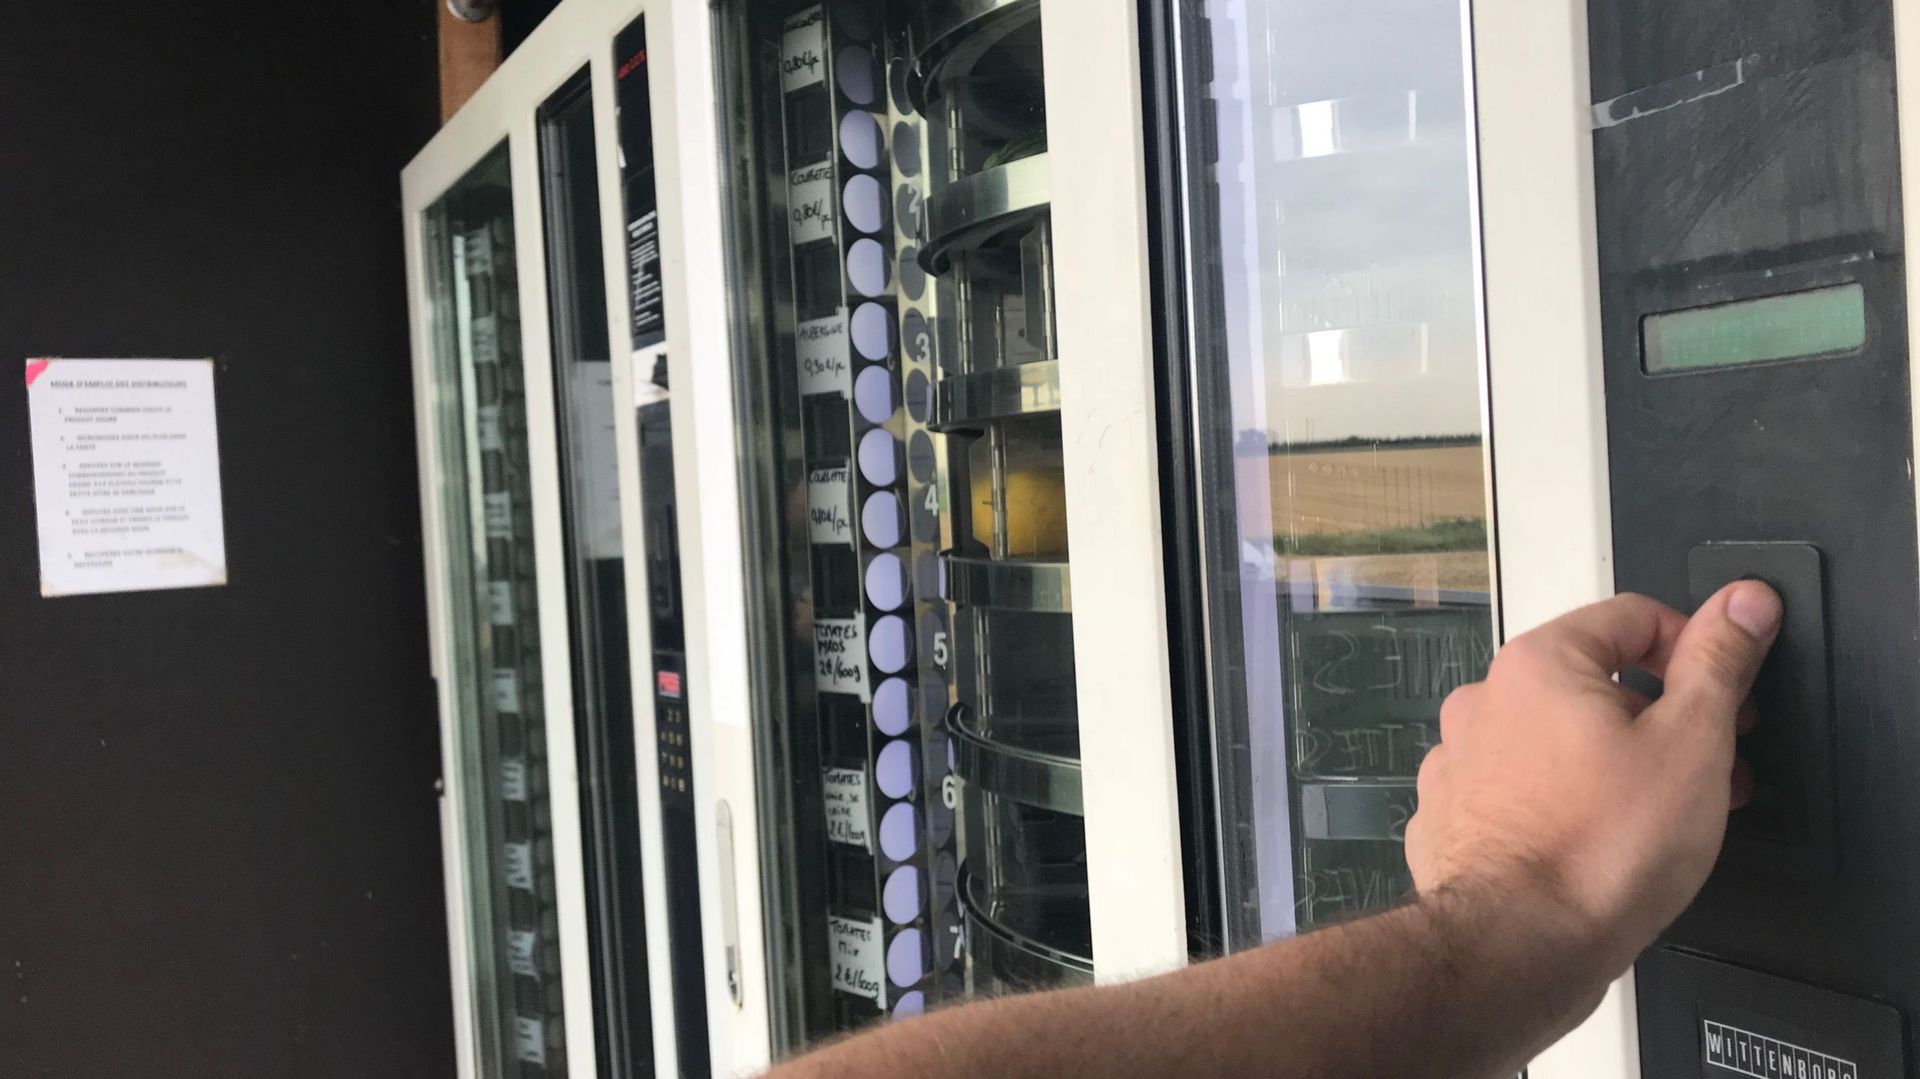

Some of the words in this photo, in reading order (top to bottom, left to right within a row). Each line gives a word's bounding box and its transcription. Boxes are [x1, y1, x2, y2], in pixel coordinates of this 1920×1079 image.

[915, 332, 930, 363] 3
[924, 484, 939, 516] 4
[933, 632, 948, 666] 5
[942, 775, 957, 809] 6
[1708, 1033, 1852, 1079] WITTENBOR
